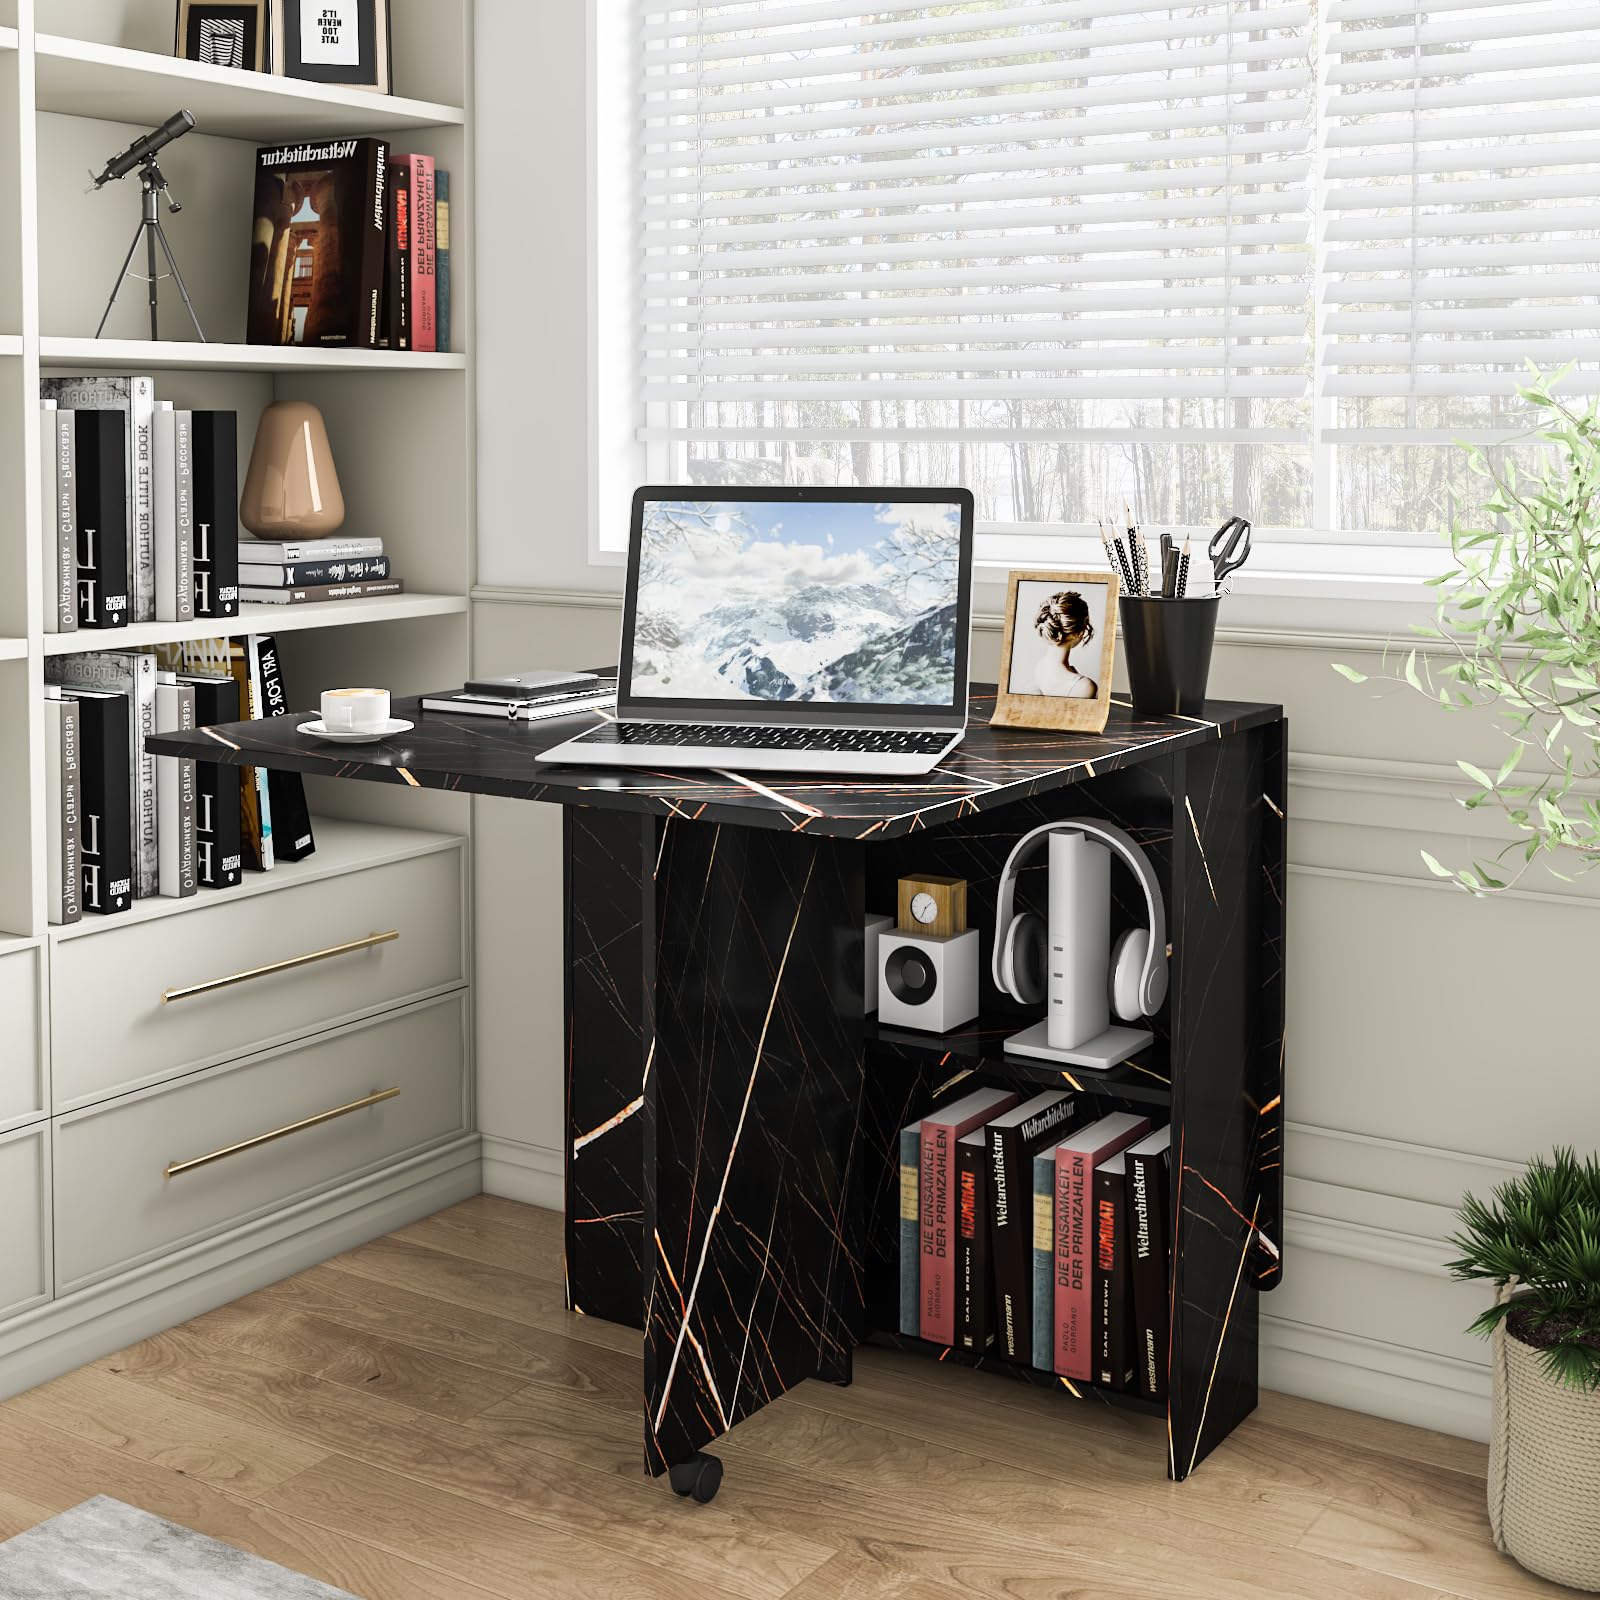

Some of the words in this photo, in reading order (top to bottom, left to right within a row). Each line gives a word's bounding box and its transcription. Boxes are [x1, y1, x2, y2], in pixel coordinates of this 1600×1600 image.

[1021, 1100, 1075, 1142] Weltarchitektur
[924, 1138, 934, 1227] EINSAMKEIT
[936, 1130, 947, 1224] PRIMZAHLEN
[993, 1132, 1008, 1226] Weltarchitektur
[1072, 1157, 1084, 1255] PRIMZAHLEN
[1134, 1160, 1150, 1258] Weltarchitektur
[923, 1232, 933, 1255] DIE
[936, 1228, 946, 1258] DER
[1059, 1167, 1070, 1258] EINSAMKEIT
[1059, 1263, 1069, 1288] DIE
[1072, 1259, 1083, 1290] DER
[1003, 1294, 1015, 1356] westermann
[1145, 1329, 1157, 1393] westermann
